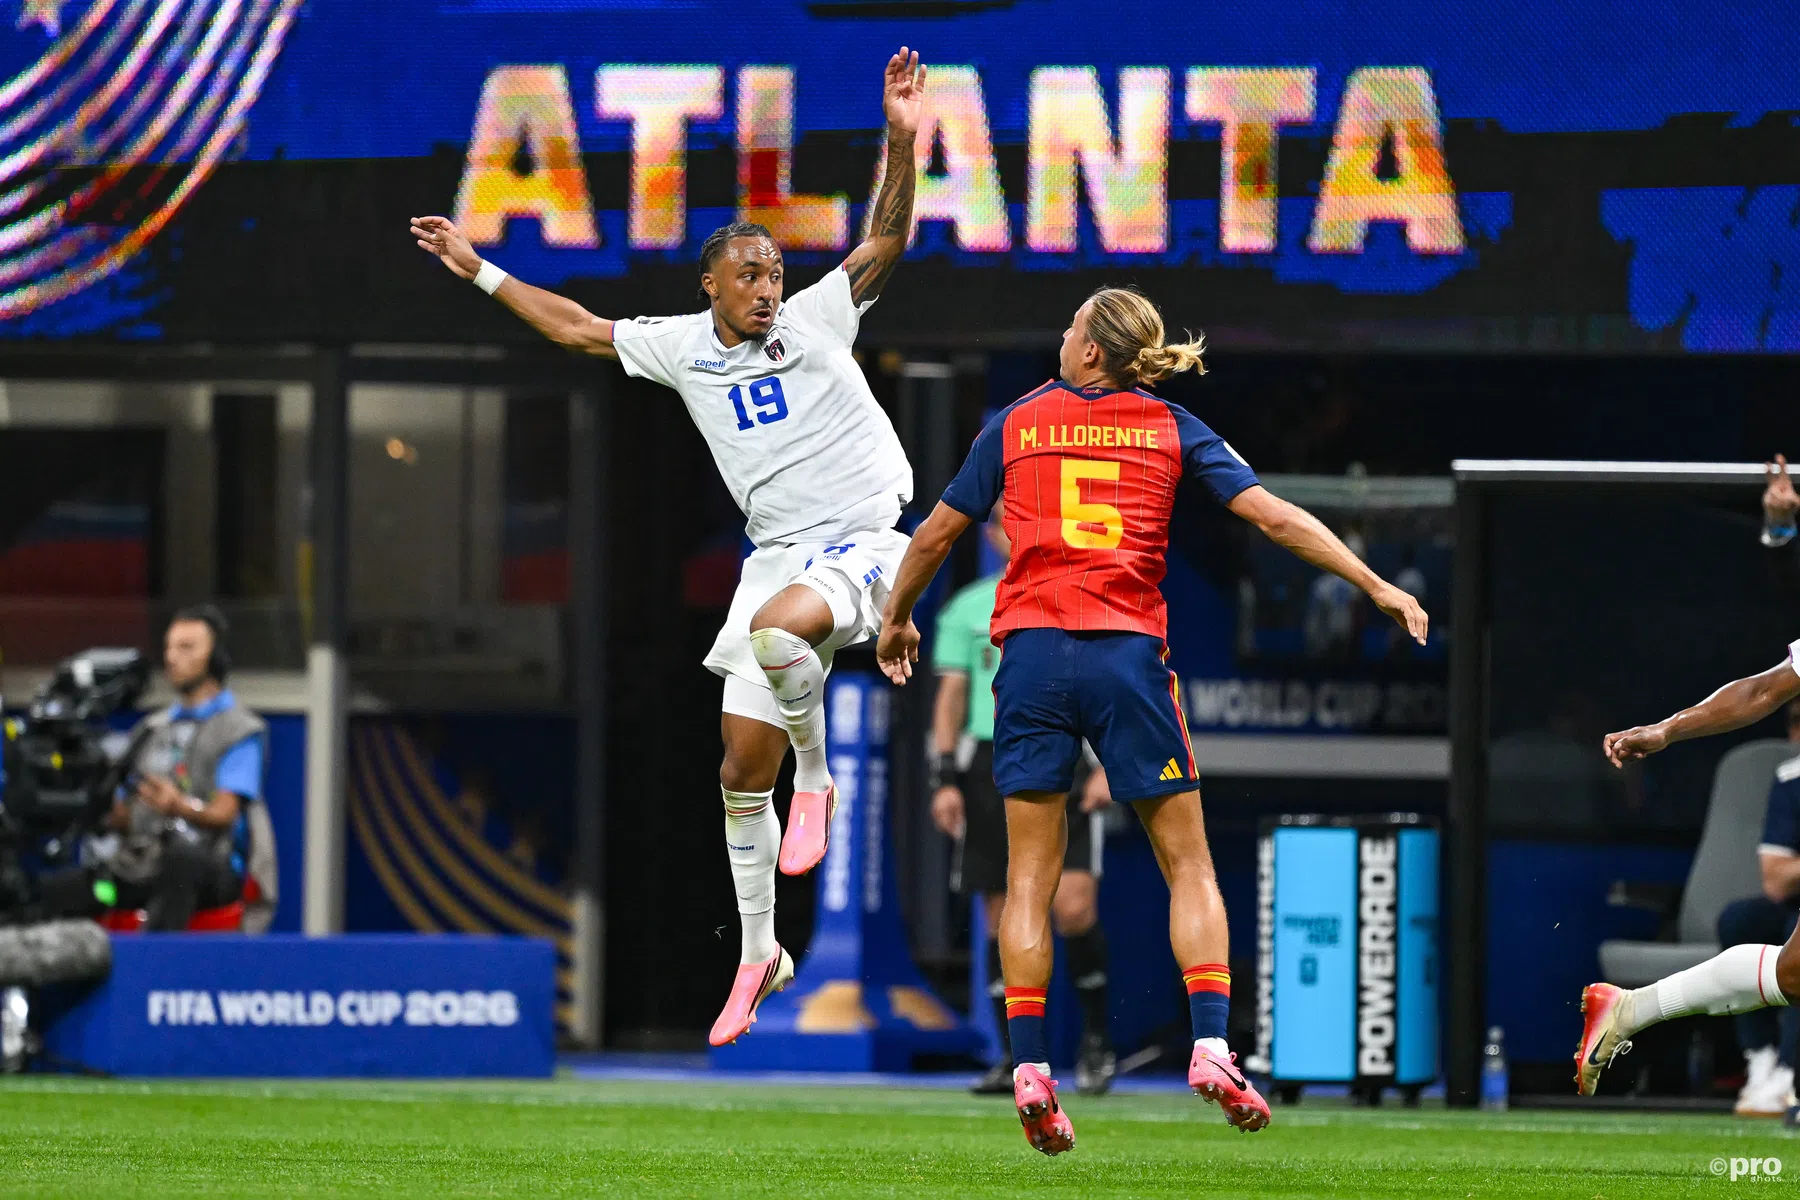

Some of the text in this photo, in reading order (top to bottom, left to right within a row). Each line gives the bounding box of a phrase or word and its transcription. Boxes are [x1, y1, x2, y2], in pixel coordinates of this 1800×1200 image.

[452, 64, 1466, 253] ATLANTA
[694, 359, 726, 368] capelli
[728, 376, 789, 431] 19
[1020, 425, 1159, 450] M. LLORENTE
[1060, 459, 1124, 549] 5
[1190, 678, 1311, 727] WORLD
[1358, 837, 1396, 1076] POWERADE
[148, 990, 519, 1026] FIFA WORLD CUP 2026
